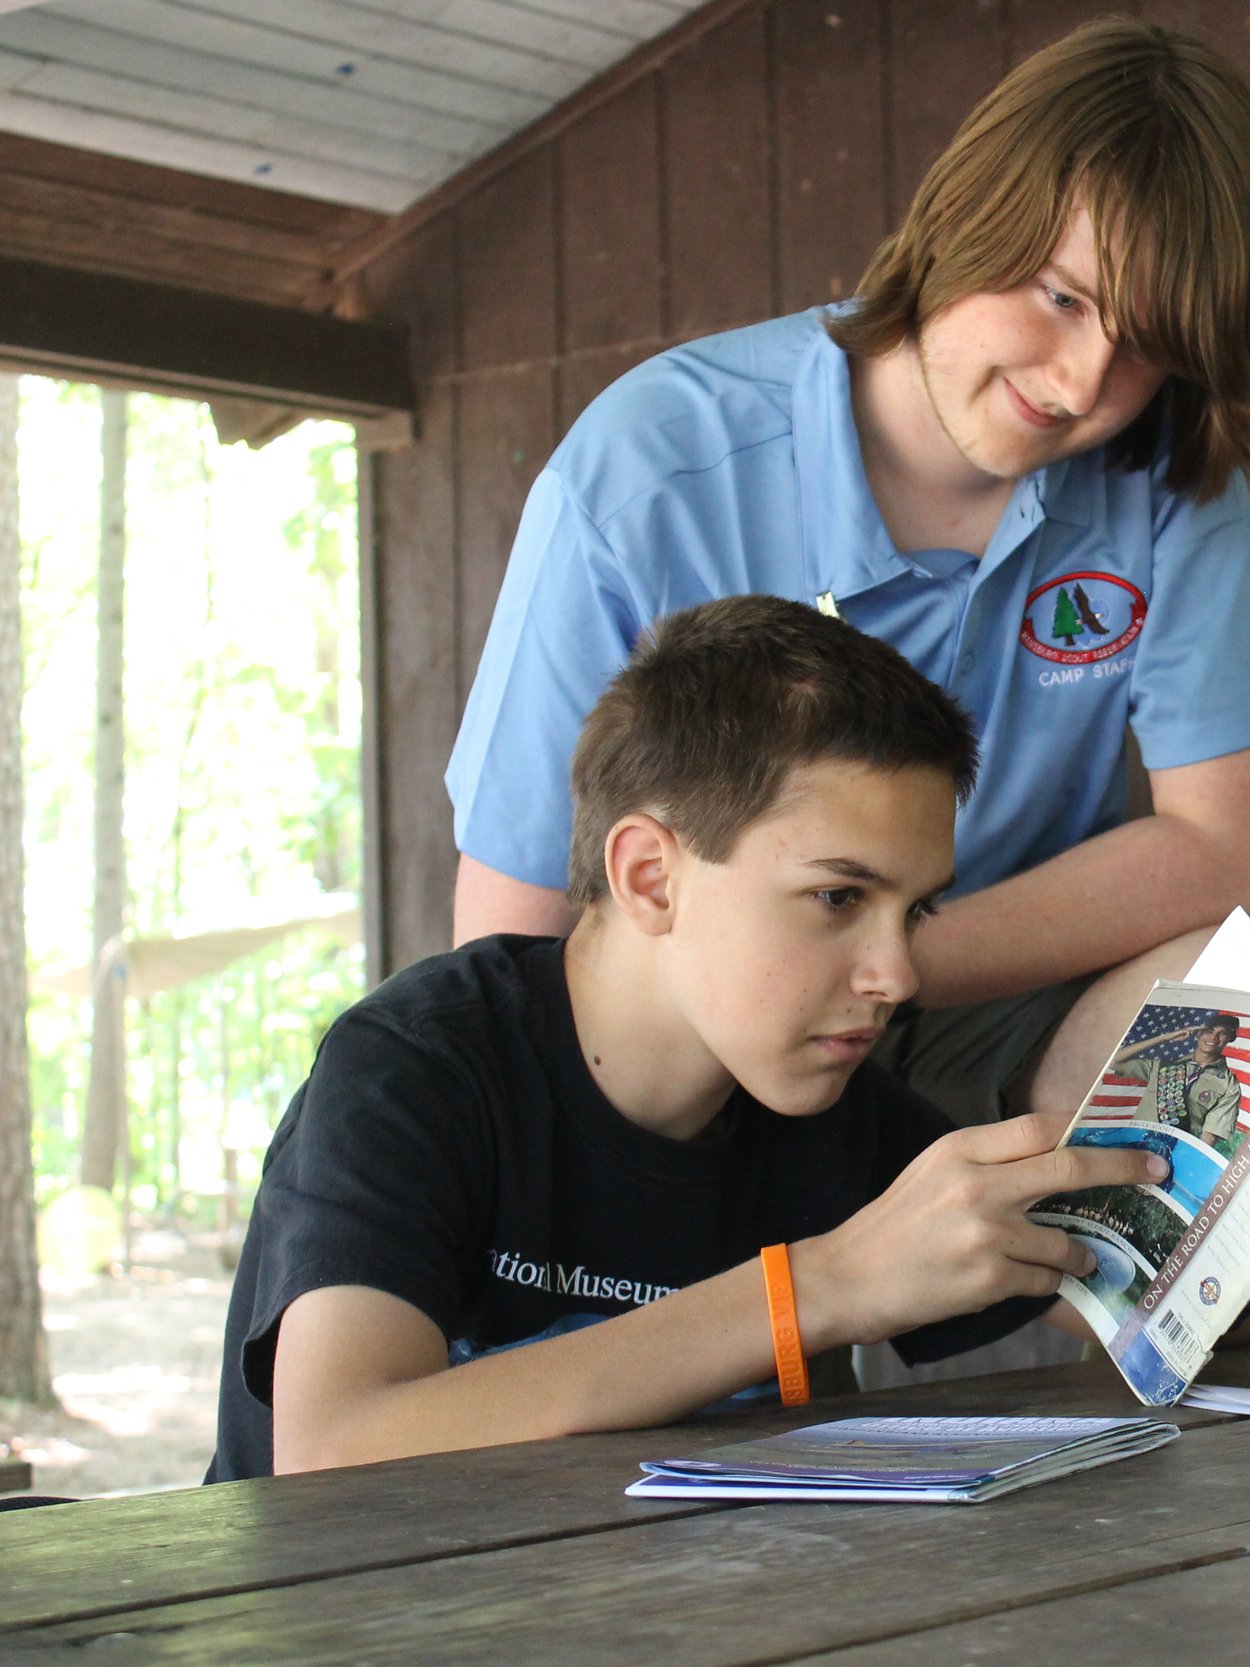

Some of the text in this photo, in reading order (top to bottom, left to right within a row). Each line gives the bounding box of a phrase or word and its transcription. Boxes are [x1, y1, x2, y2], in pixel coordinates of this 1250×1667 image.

[1039, 667, 1084, 687] CAMP
[1129, 1120, 1176, 1134] EAGLE SCOUT
[1087, 1221, 1110, 1234] SCOUT
[1112, 1231, 1134, 1254] RANCH
[1143, 1284, 1164, 1310] ON
[1160, 1256, 1184, 1284] THE
[1183, 1215, 1210, 1260] ROAD
[1207, 1195, 1225, 1221] TO
[1222, 1154, 1250, 1194] HIGH
[775, 1326, 804, 1404] SBURG
